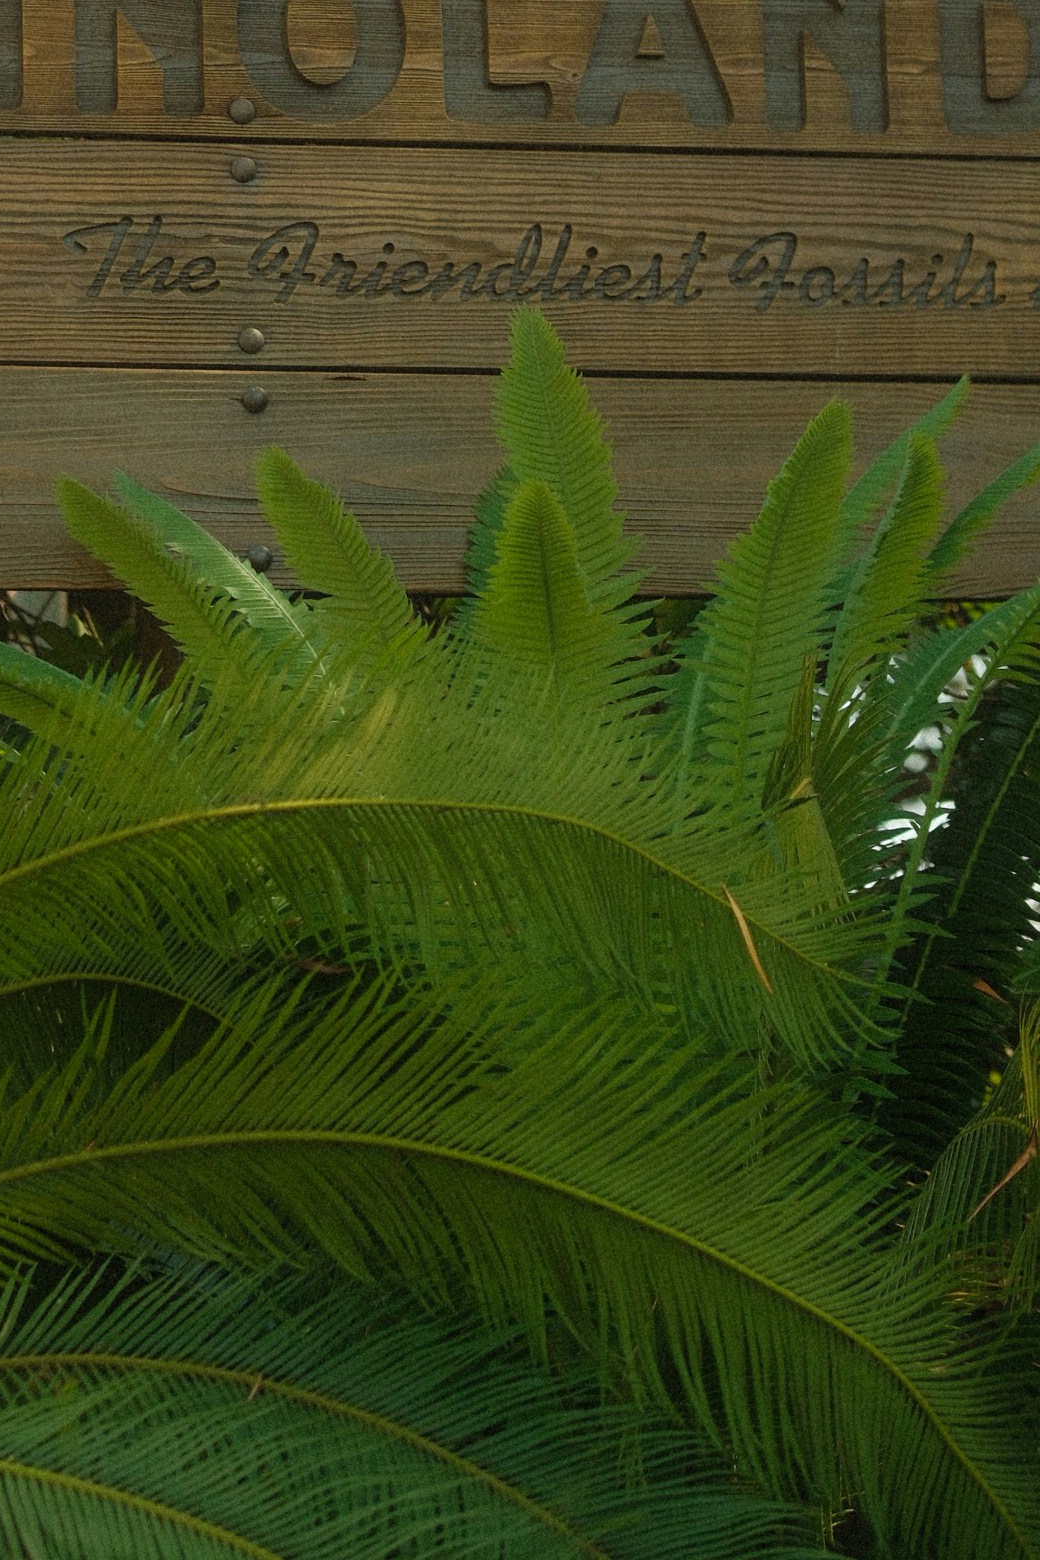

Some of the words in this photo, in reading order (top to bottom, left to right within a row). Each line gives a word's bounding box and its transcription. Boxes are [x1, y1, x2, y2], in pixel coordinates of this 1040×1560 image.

[63, 215, 221, 297] The
[247, 221, 707, 307] Friendliest
[728, 231, 1007, 313] Fossils
